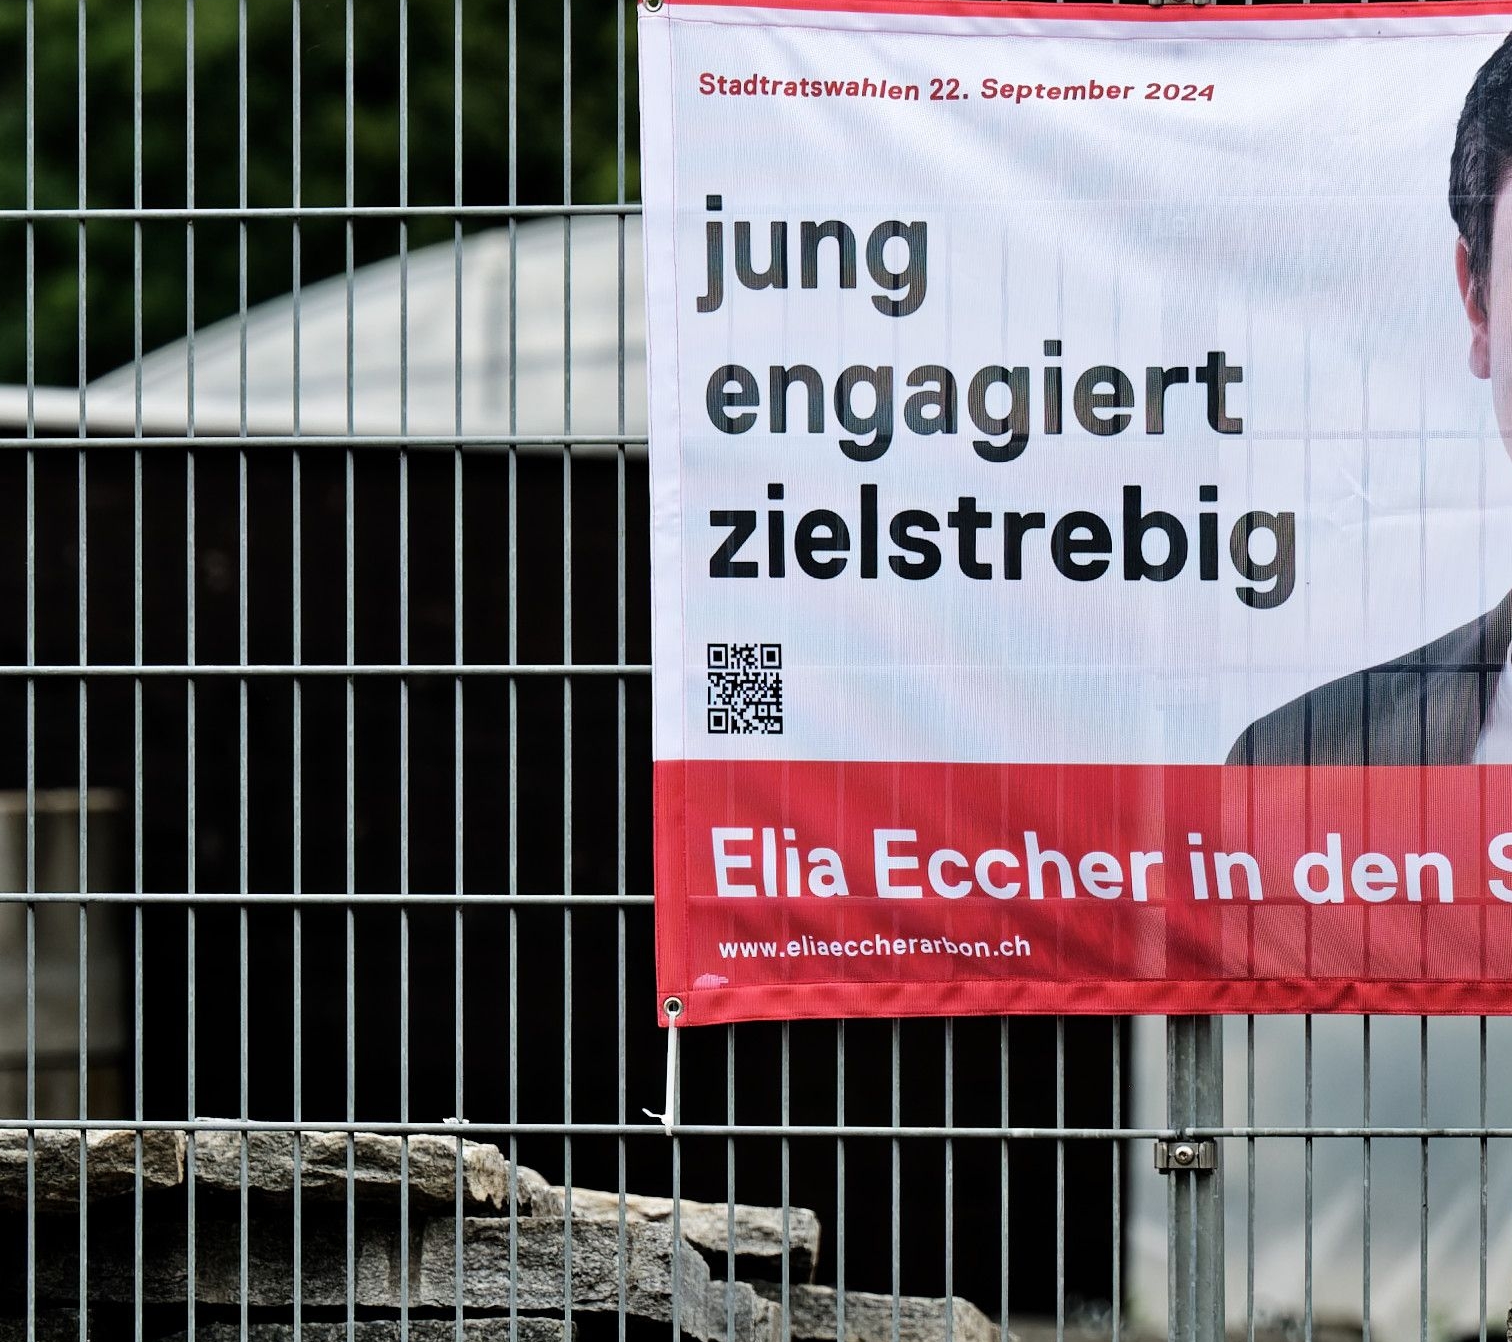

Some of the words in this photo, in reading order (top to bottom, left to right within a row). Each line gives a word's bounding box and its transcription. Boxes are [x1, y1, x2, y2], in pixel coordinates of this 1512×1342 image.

[698, 73, 921, 102] Stadtratswahlen
[929, 77, 970, 102] 22.
[980, 78, 1136, 107] September
[1143, 81, 1215, 103] 2024
[696, 194, 929, 316] jung
[706, 340, 1244, 462] engagiert
[709, 484, 1297, 611] zielstrebig
[711, 826, 850, 903] Elia
[873, 827, 1164, 903] Eccher
[1190, 832, 1263, 903] in
[1292, 834, 1456, 905] den
[718, 934, 1032, 960] www.eliaeccherarbon.ch
